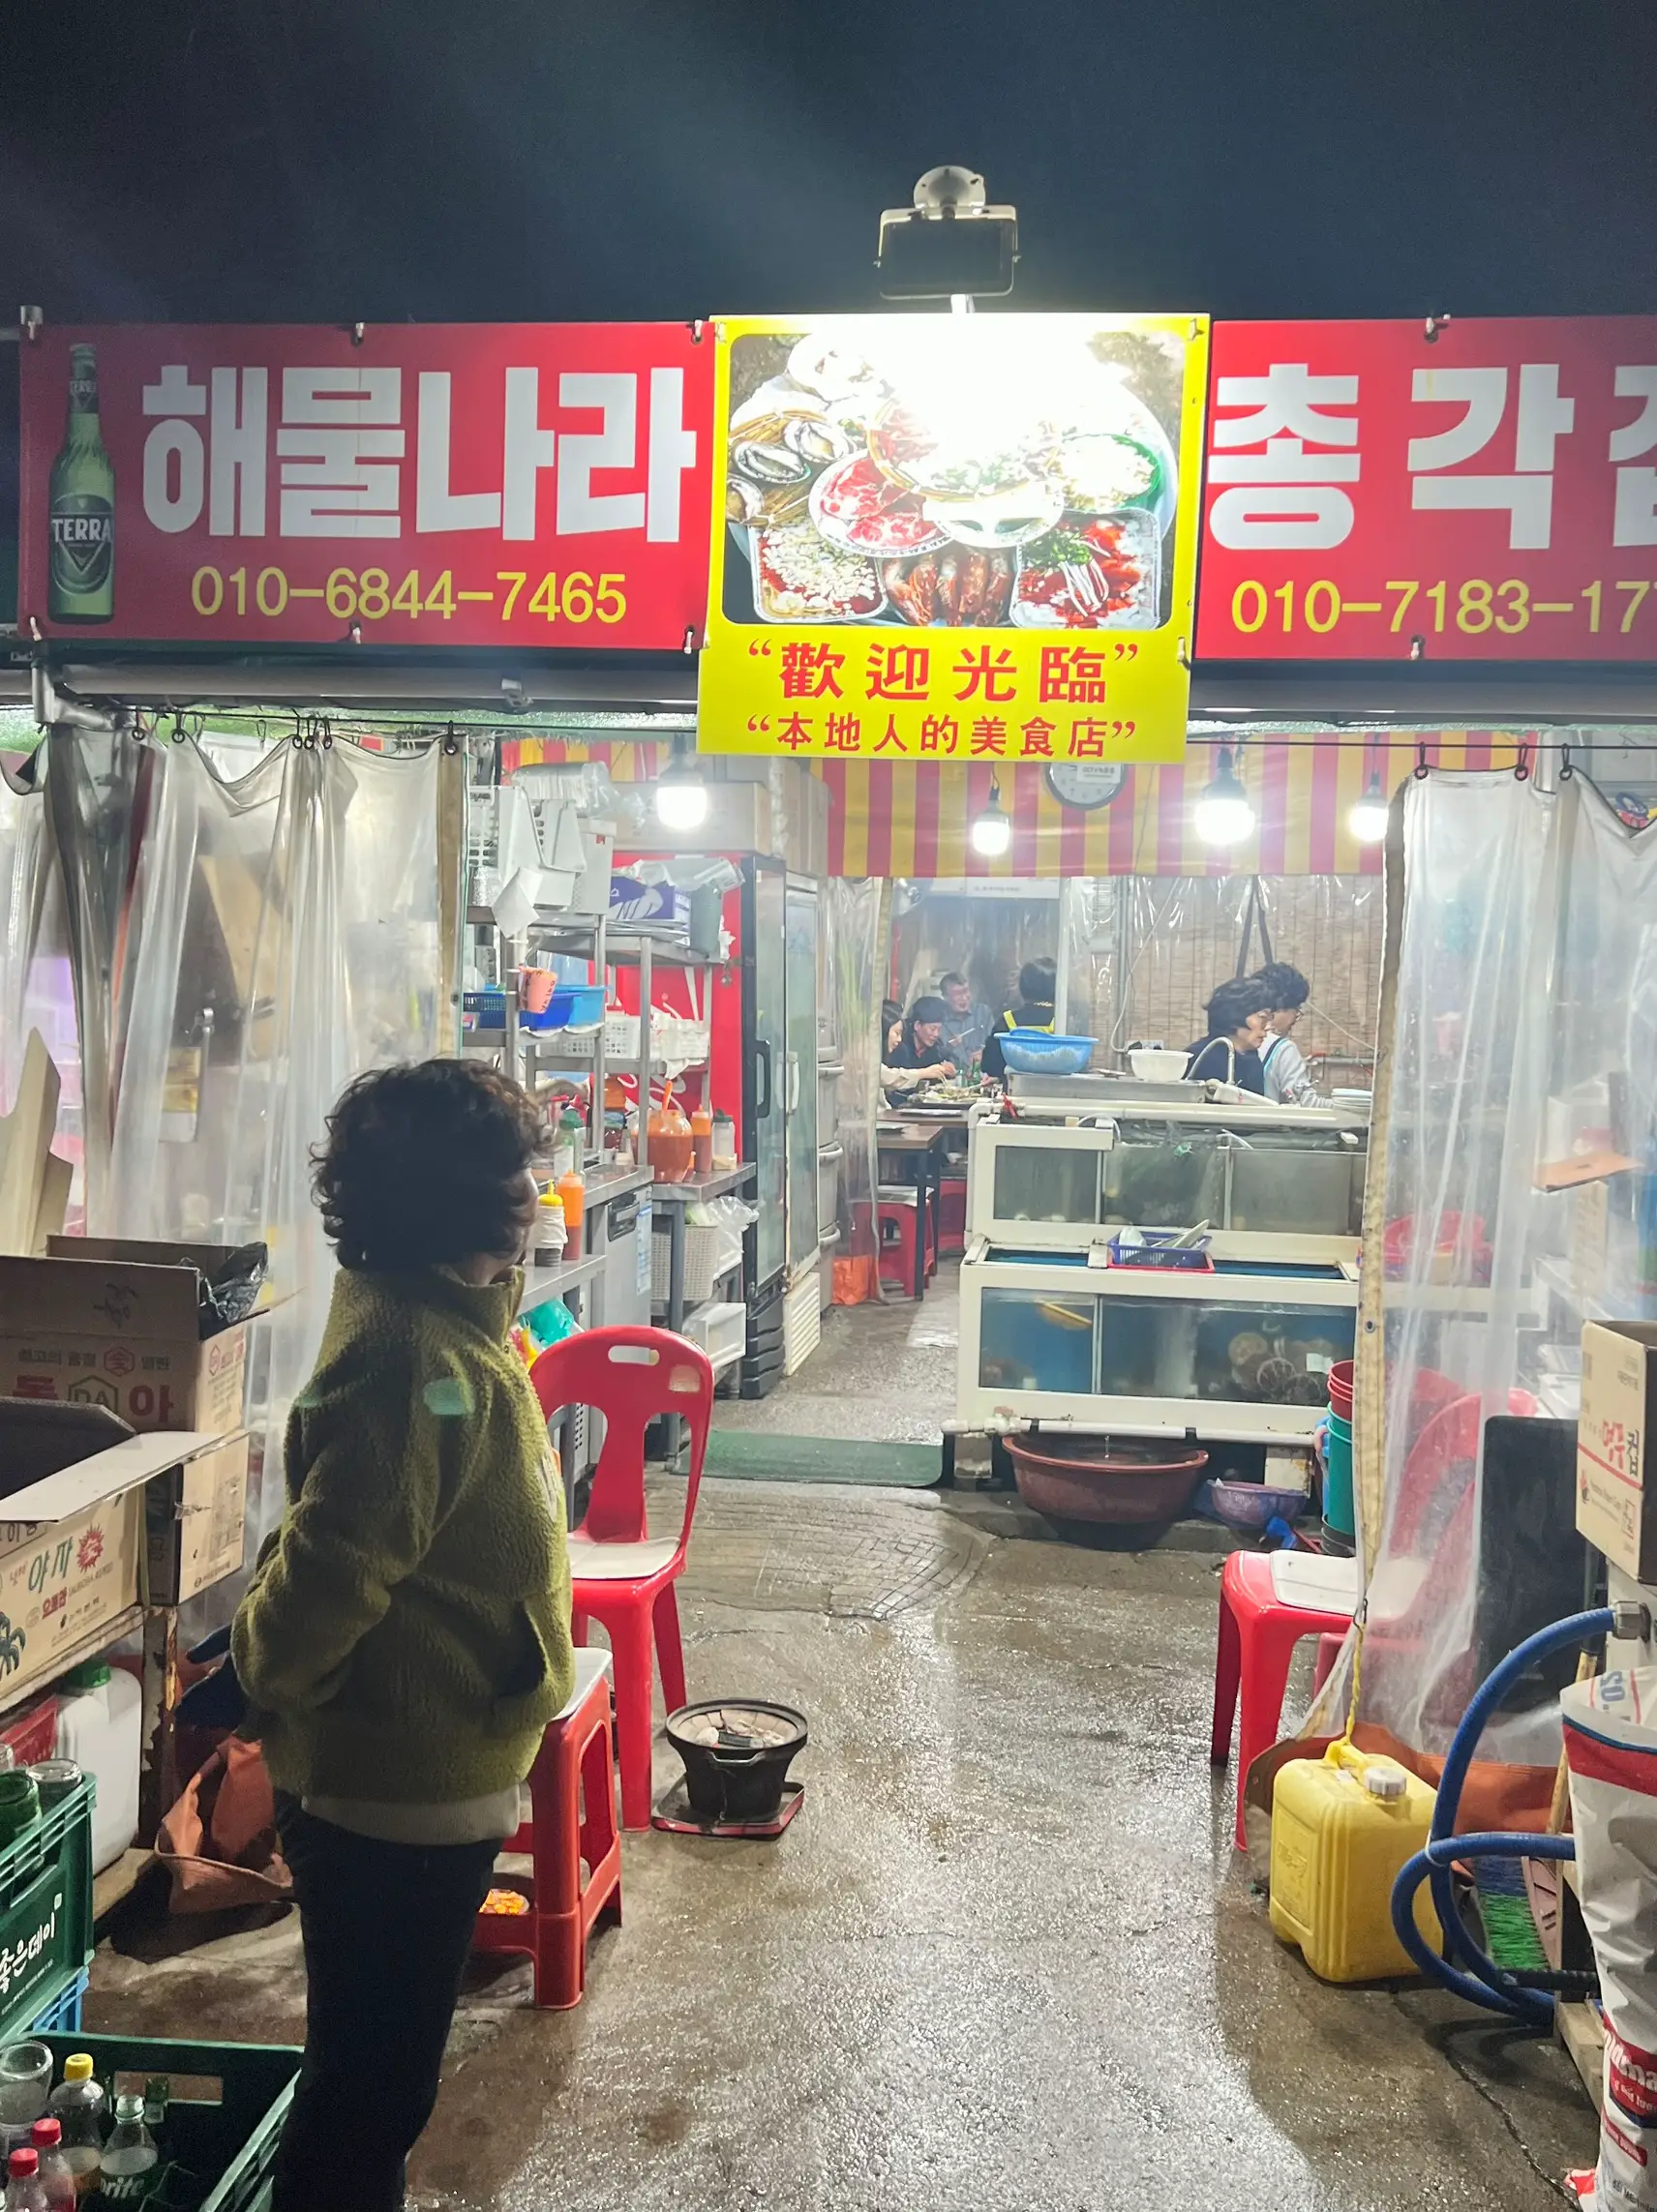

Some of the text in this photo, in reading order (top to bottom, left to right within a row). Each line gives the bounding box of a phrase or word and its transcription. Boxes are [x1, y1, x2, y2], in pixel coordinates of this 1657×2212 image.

[142, 365, 697, 543] 해물나라
[51, 518, 112, 543] TERRA
[191, 564, 627, 624] 010-6844-7465
[1231, 579, 1657, 634] 010-7183-17
